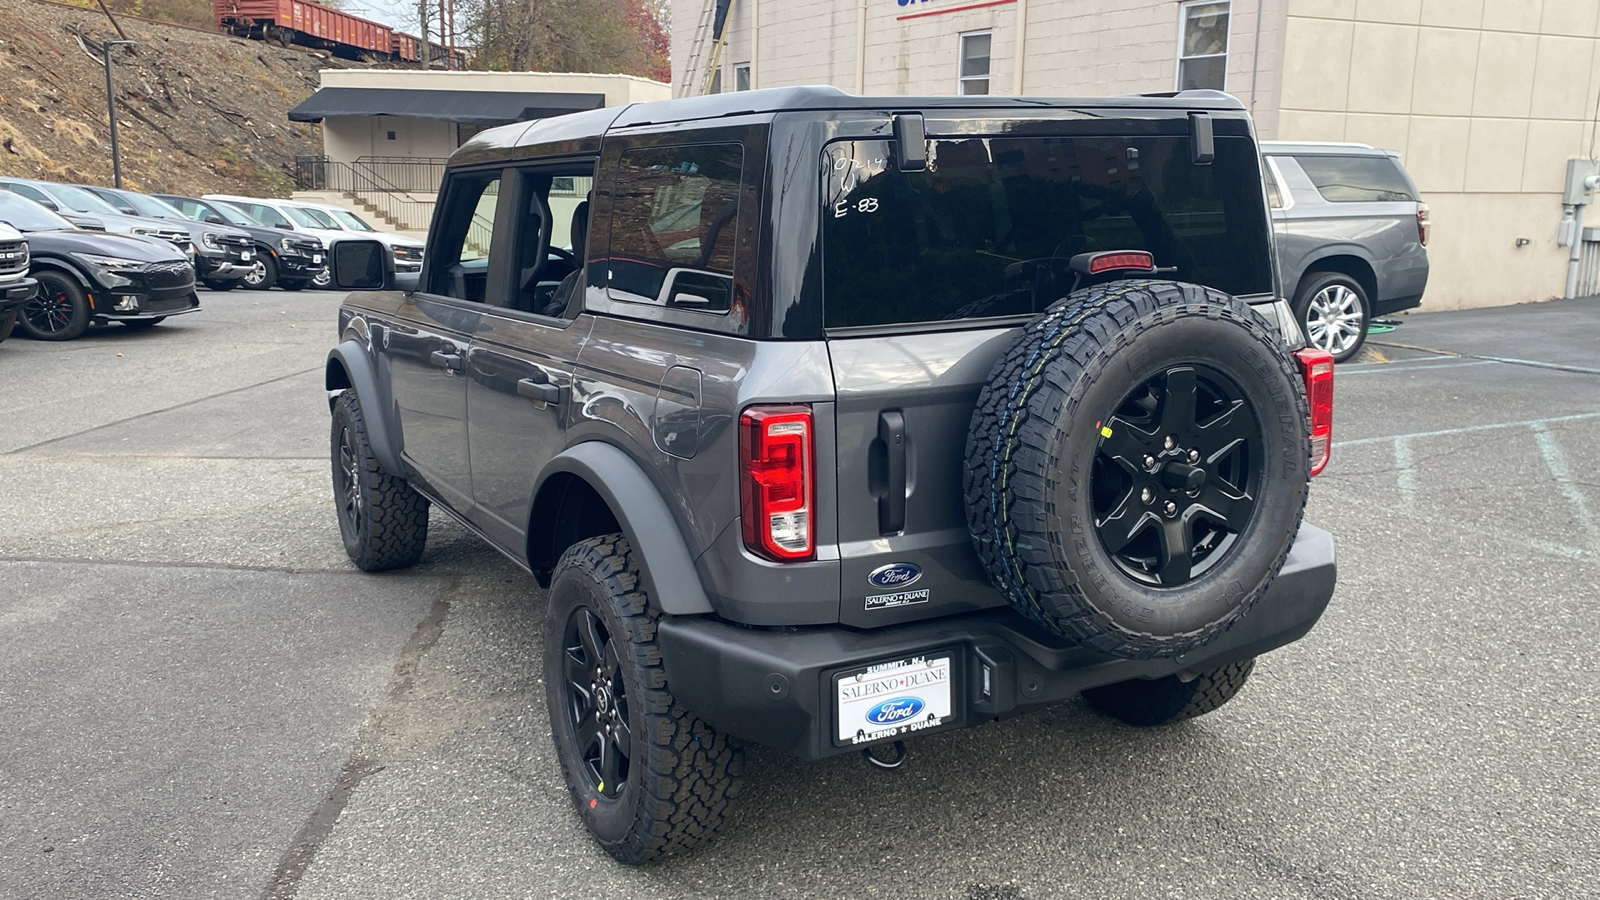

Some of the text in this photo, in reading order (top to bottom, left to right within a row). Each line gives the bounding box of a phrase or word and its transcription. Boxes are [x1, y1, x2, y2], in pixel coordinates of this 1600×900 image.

[1239, 346, 1298, 479] GENERAL
[881, 569, 911, 583] Ford
[867, 595, 898, 605] SALERNO
[904, 591, 927, 600] DUANE
[912, 656, 925, 665] NJ
[842, 668, 946, 701] SALERNO DUANE
[877, 700, 914, 722] Ford
[852, 717, 942, 745] SALERNO DUANE
